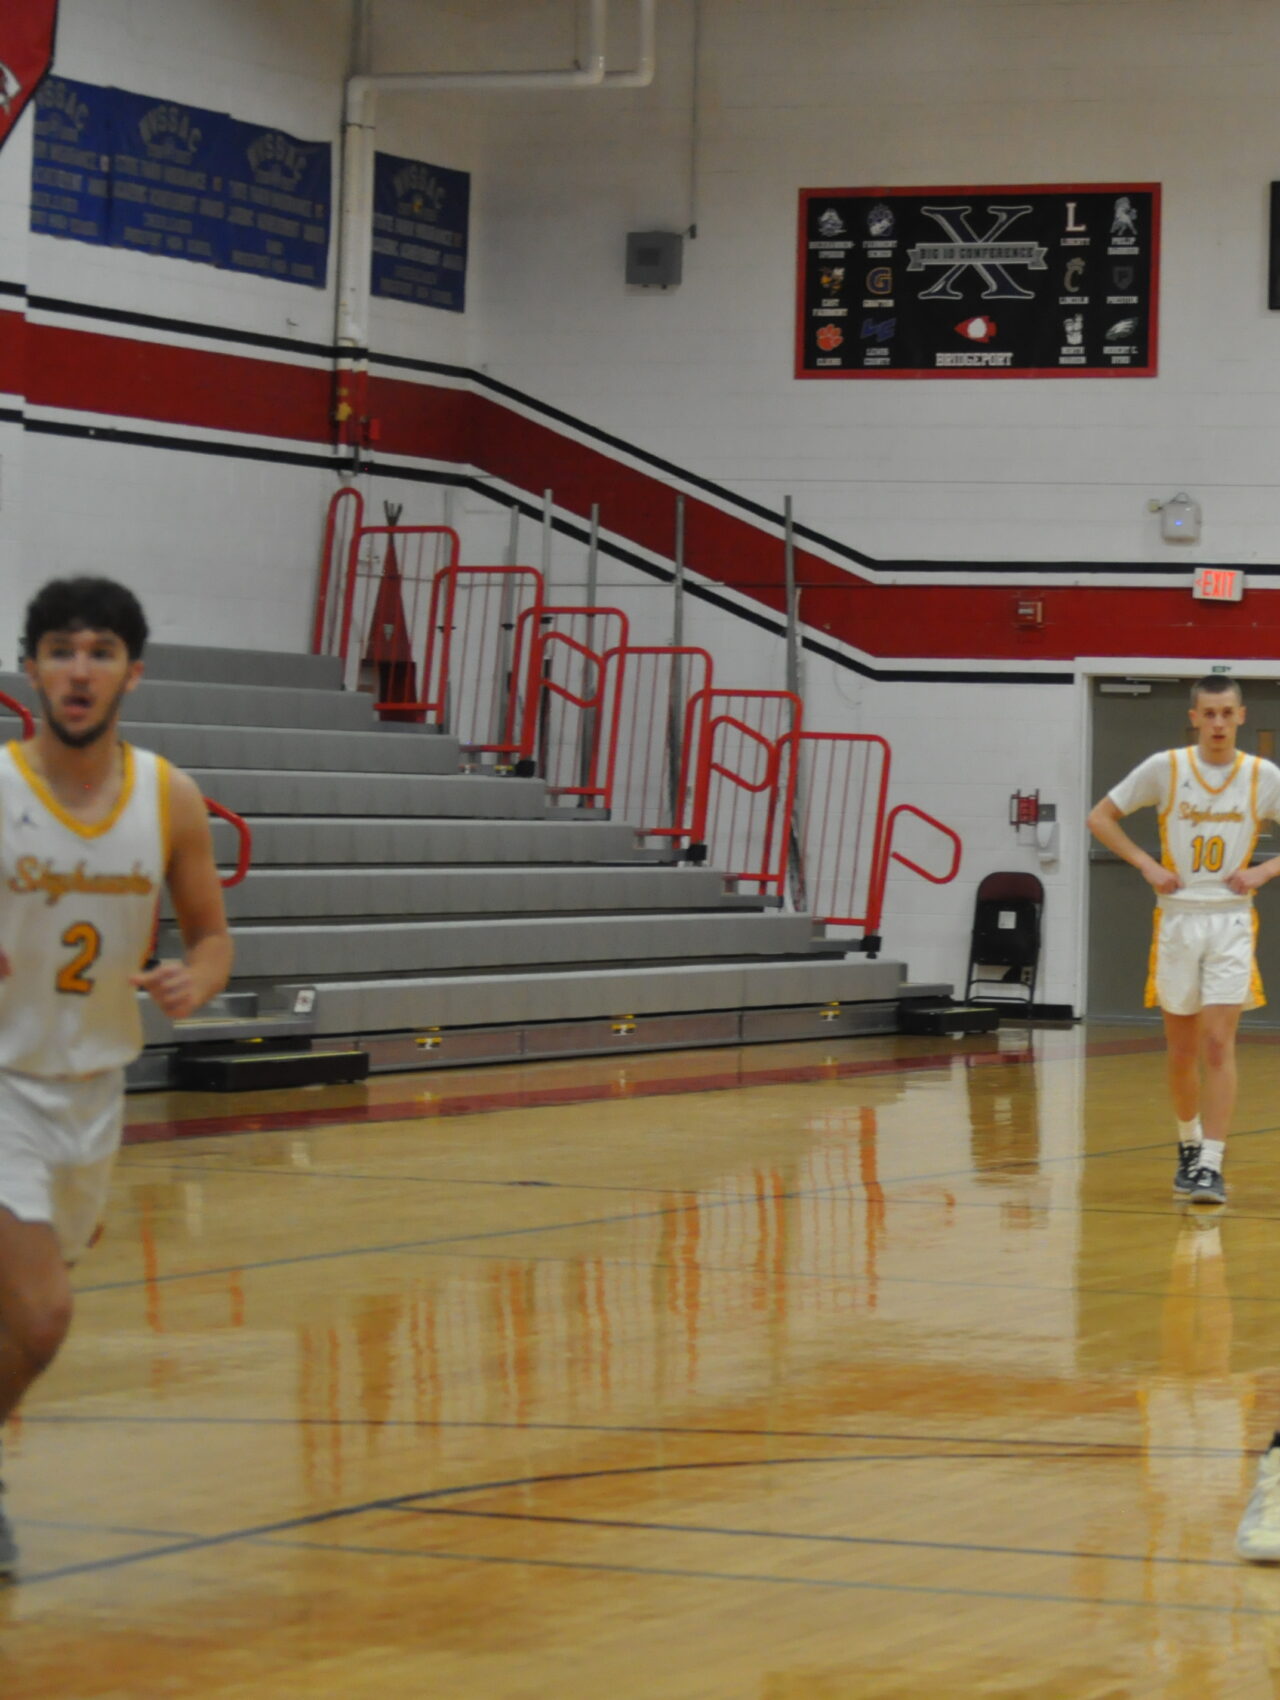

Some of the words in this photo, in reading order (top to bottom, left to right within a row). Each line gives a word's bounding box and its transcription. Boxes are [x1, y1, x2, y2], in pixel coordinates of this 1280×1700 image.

[1065, 202, 1087, 232] L
[935, 352, 1014, 366] BRIDGEPORT
[1202, 570, 1237, 598] EXIT
[1191, 835, 1225, 873] 10
[55, 921, 102, 994] 2
